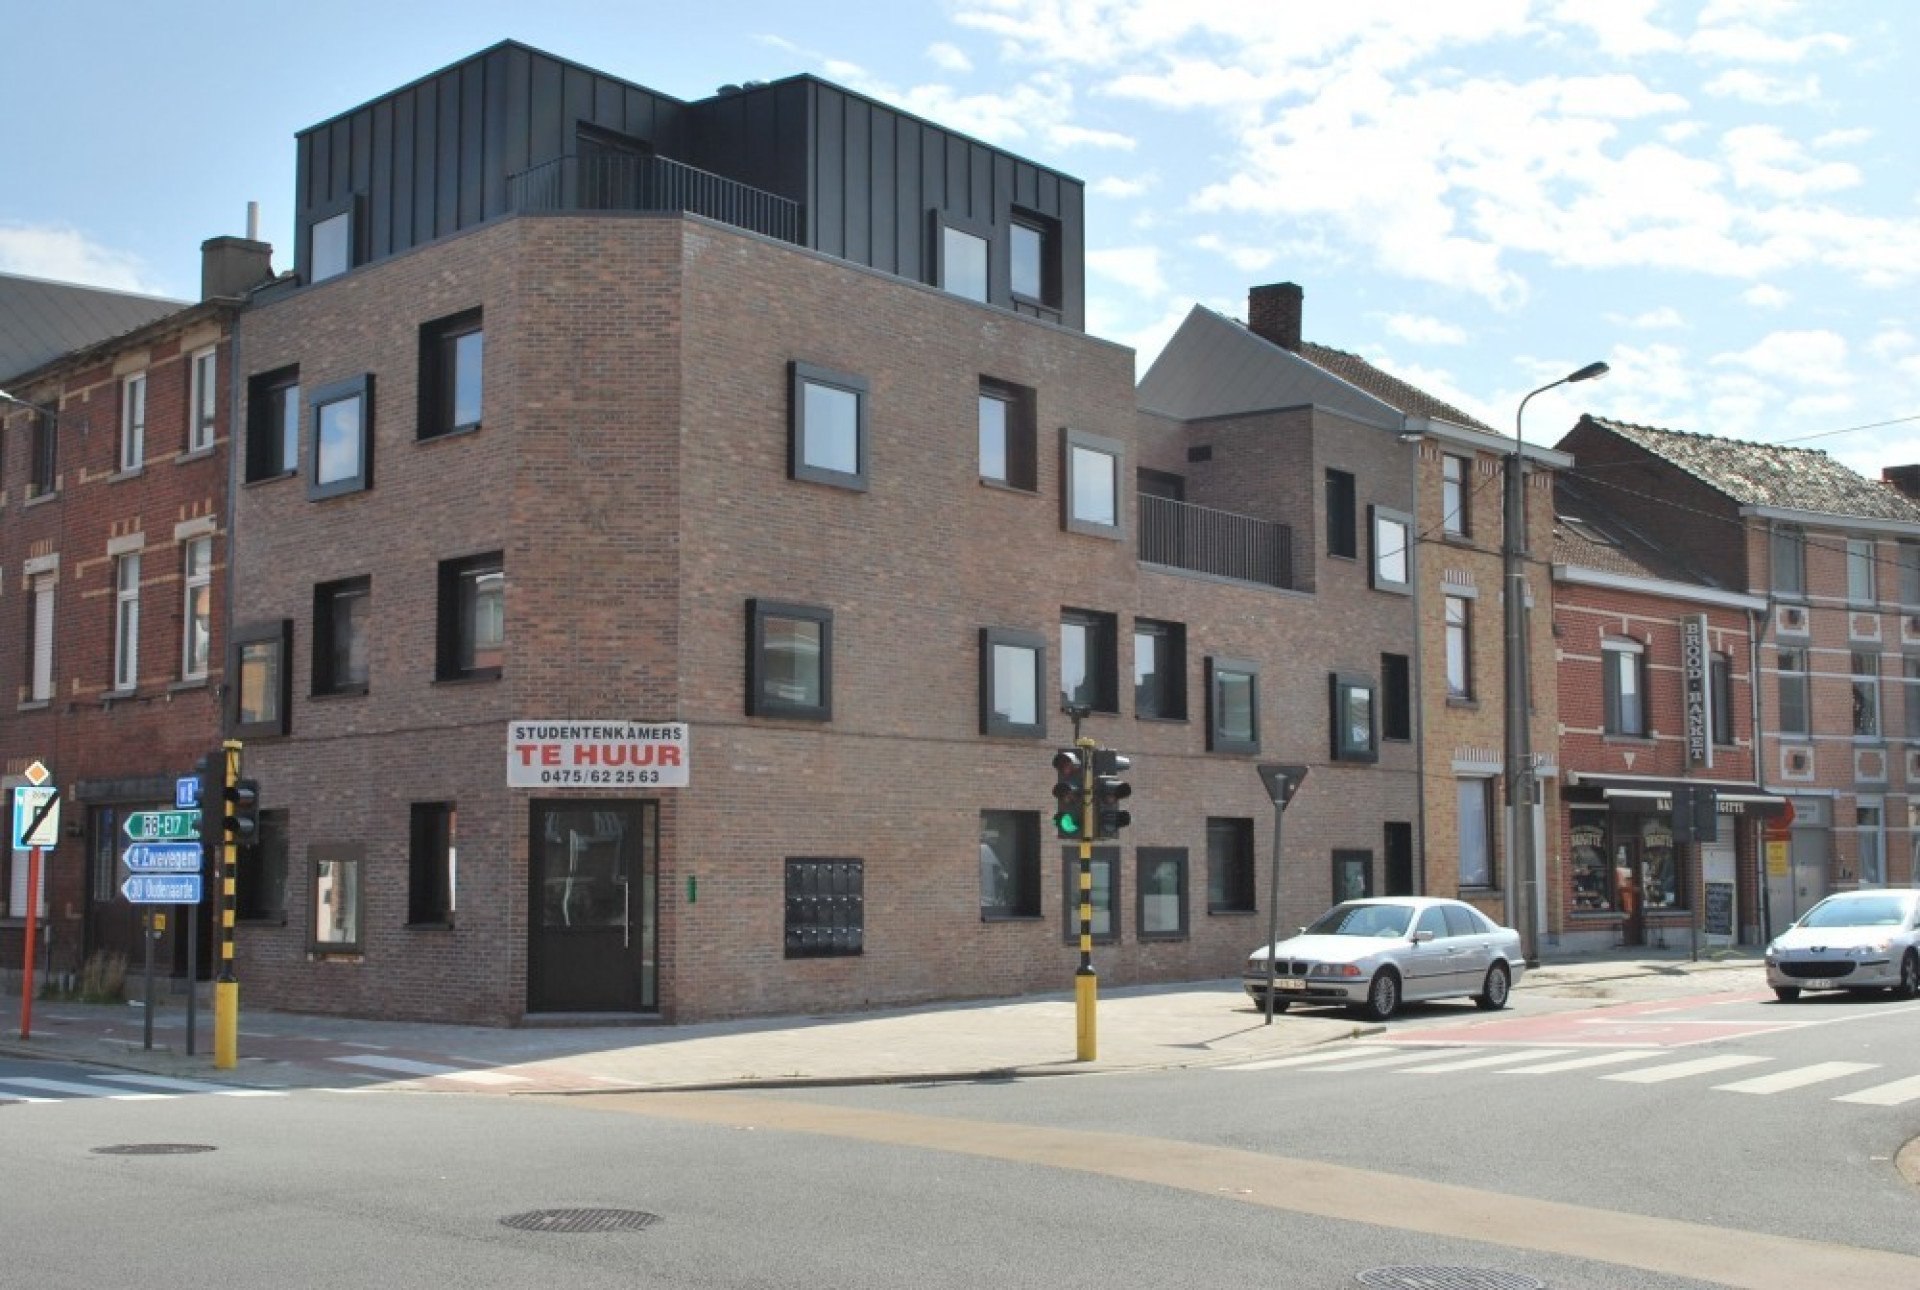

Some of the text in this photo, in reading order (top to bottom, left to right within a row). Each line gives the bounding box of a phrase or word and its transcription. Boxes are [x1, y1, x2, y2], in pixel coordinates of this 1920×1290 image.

[1687, 623, 1701, 678] BROOD
[515, 726, 683, 740] STUDENTENKAMERS
[515, 744, 682, 767] TE HUUR
[541, 769, 660, 784] 0475/62 25 63
[141, 847, 197, 870] Zwevegem
